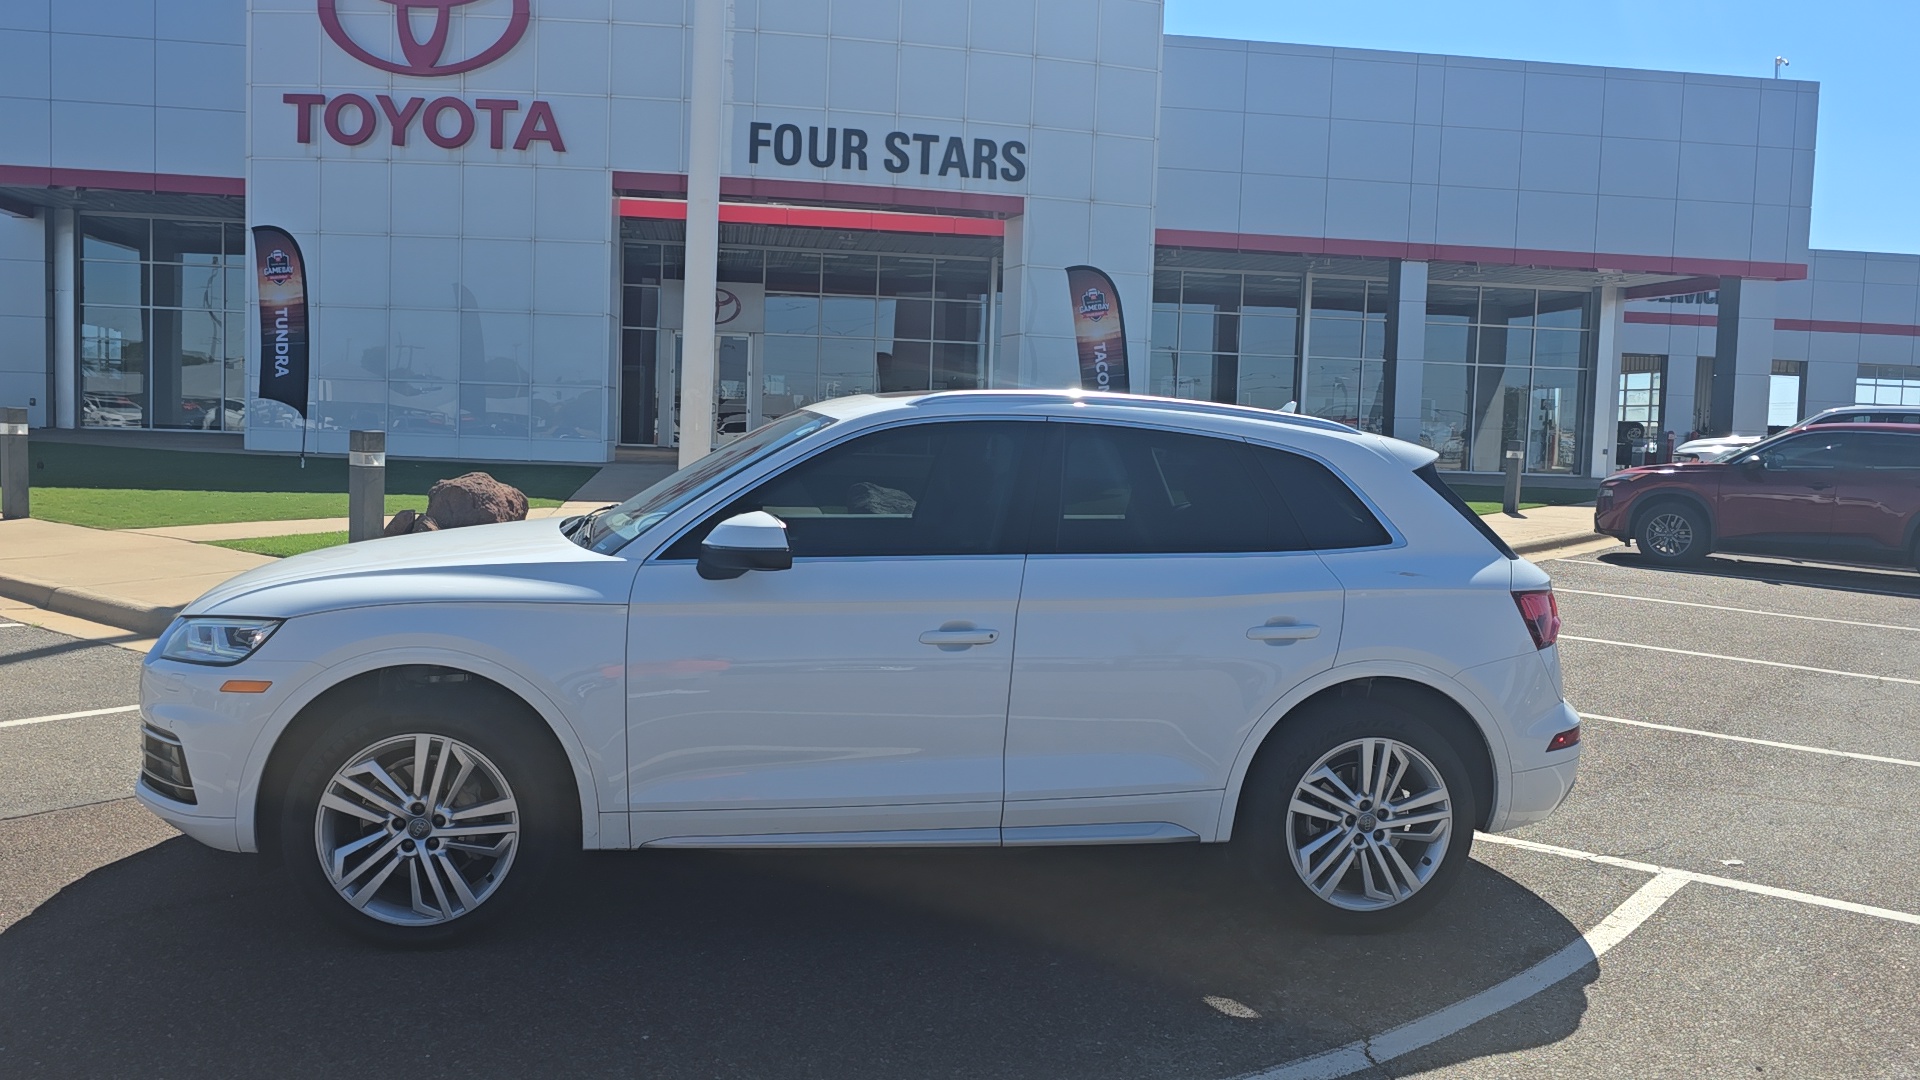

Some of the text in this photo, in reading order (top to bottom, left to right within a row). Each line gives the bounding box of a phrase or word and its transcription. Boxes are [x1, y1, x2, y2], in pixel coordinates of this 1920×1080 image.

[283, 93, 566, 152] TOYOTA
[749, 121, 1027, 182] FOUR STARS
[1079, 303, 1110, 313] GAMEDAY
[275, 308, 289, 378] TUNDRA
